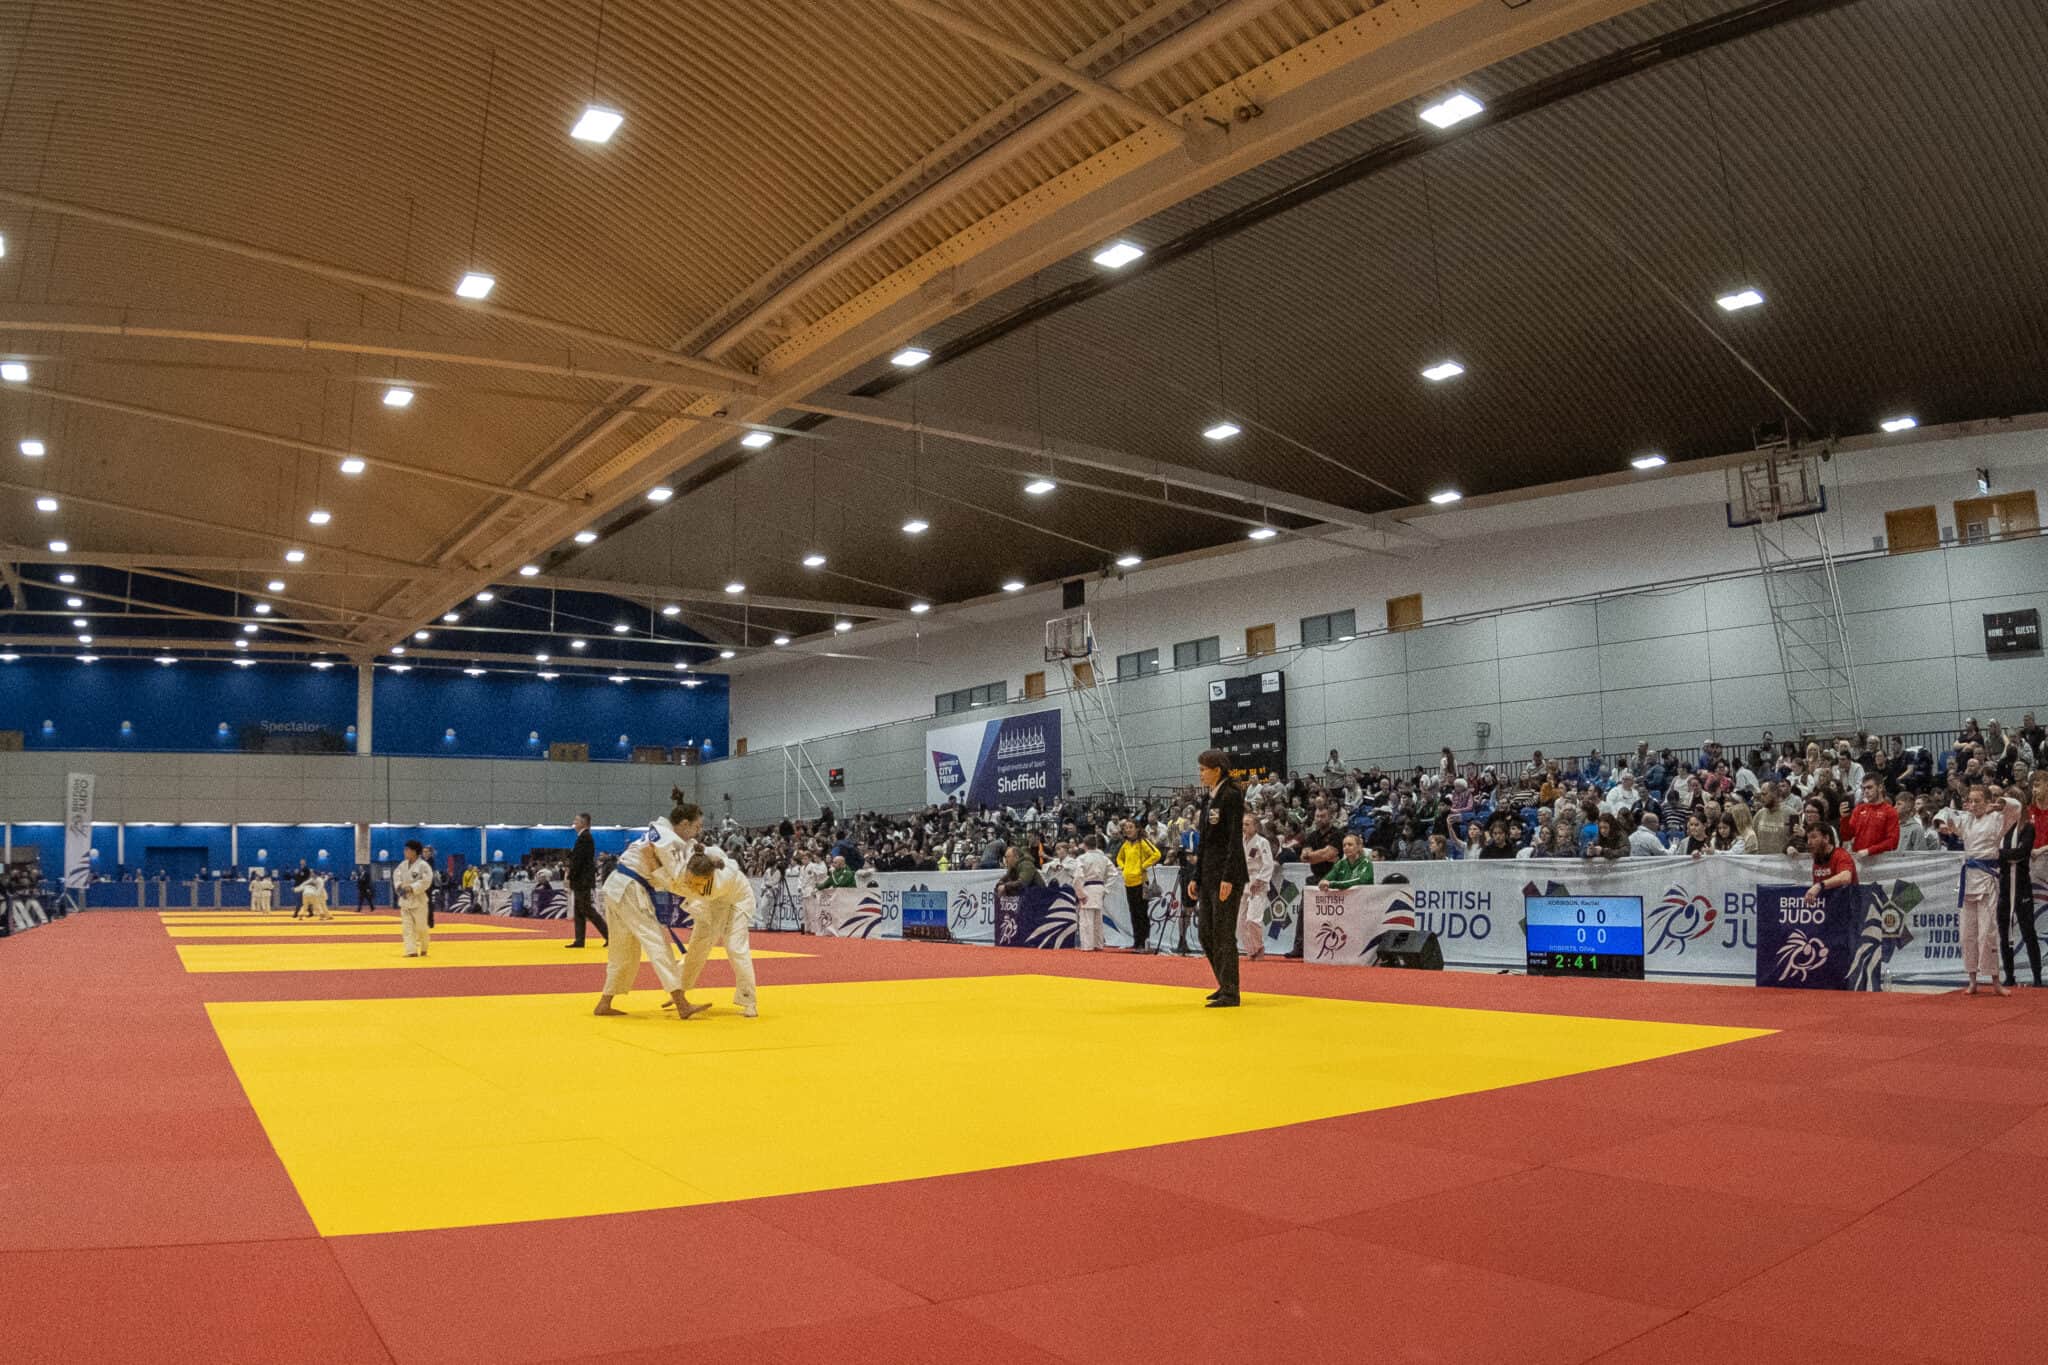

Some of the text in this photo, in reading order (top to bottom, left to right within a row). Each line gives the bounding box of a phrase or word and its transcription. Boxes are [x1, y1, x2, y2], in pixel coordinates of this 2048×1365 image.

[939, 766, 953, 775] CITY
[939, 774, 959, 785] TRUST
[998, 771, 1046, 793] Sheffield
[80, 779, 88, 813] JUDO
[882, 890, 899, 903] TISH
[1315, 895, 1345, 905] BRITISH
[1414, 890, 1492, 910] BRITISH
[1779, 897, 1826, 908] BRITISH
[882, 904, 899, 921] DO
[1315, 905, 1345, 916] JUDO
[1577, 909, 1606, 924] 0 0
[1778, 909, 1826, 925] JUDO
[1414, 912, 1492, 940] JUDO
[1913, 913, 1960, 928] EUROPE
[1577, 928, 1607, 943] 0 0
[1721, 918, 1757, 949] JU
[1928, 929, 1960, 944] JUDO
[1924, 946, 1963, 959] UNION
[1555, 954, 1598, 970] 2:41
